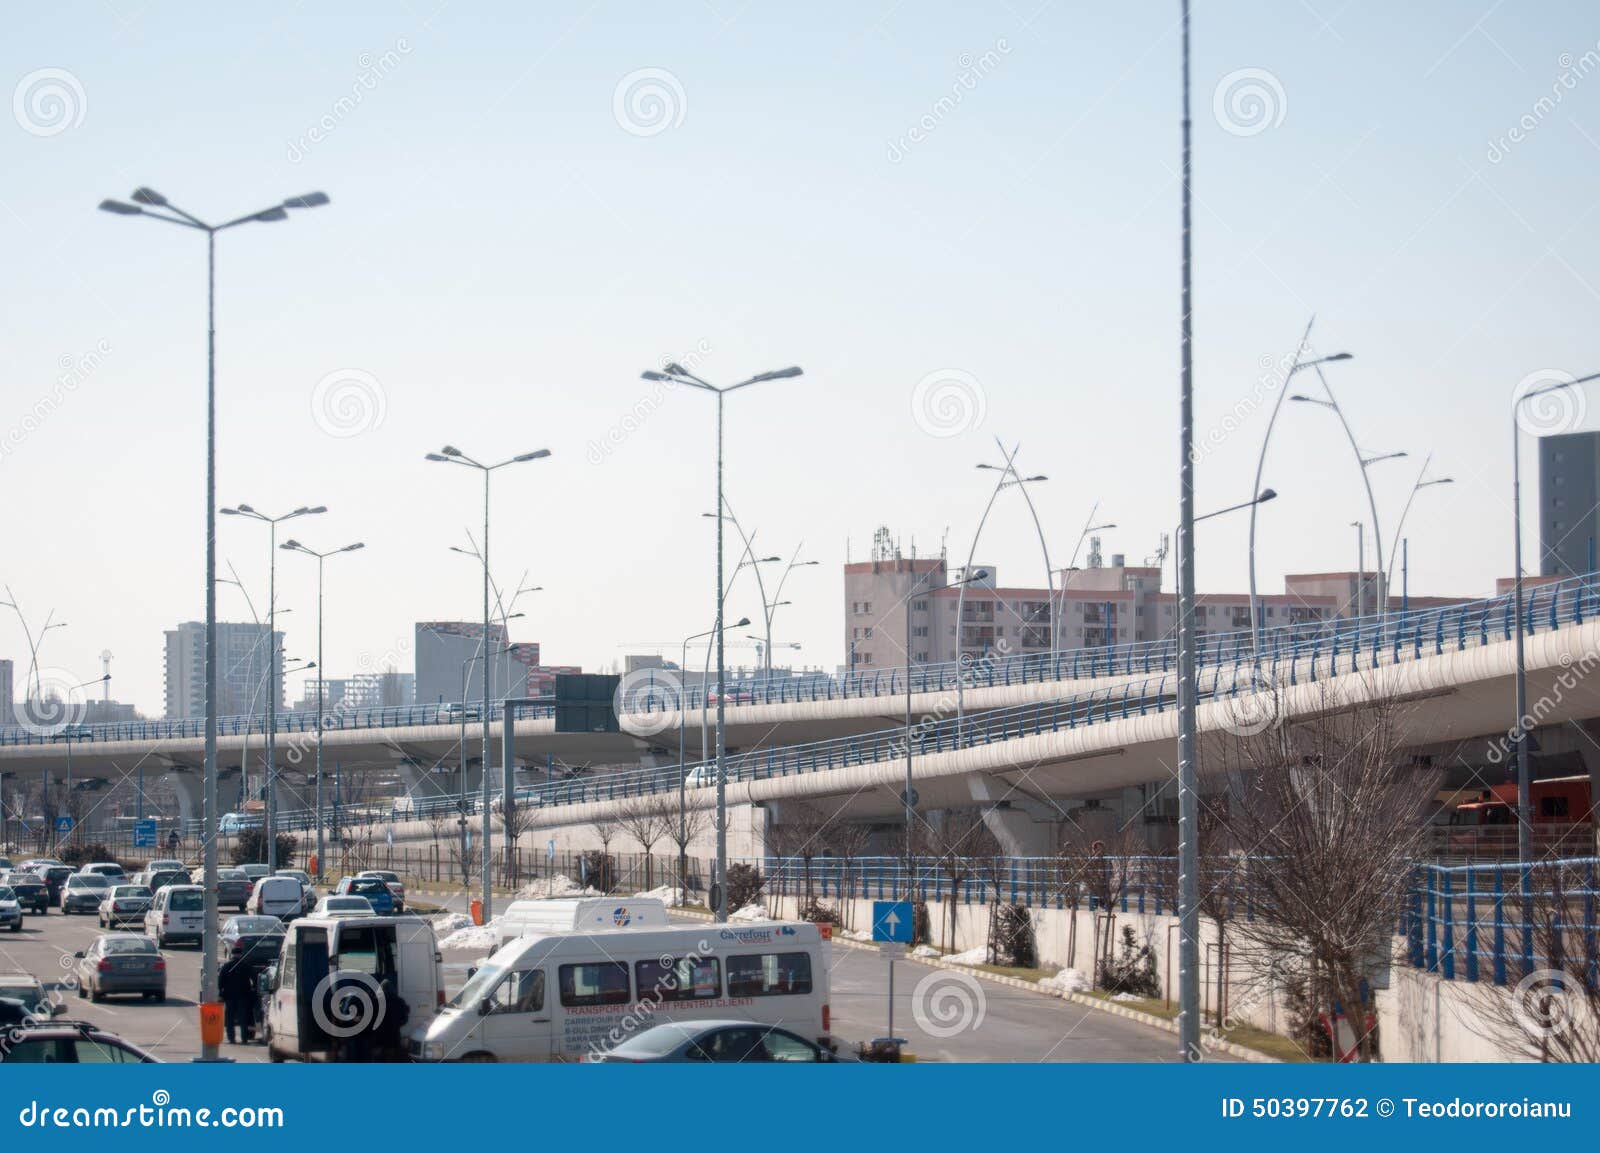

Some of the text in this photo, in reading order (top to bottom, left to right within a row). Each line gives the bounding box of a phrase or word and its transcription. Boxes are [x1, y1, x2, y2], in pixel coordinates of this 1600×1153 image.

[720, 928, 771, 940] Carrefour
[566, 1004, 624, 1015] TRANSPORT
[674, 1000, 713, 1010] PENTRU
[564, 1014, 615, 1024] CARREFOUR
